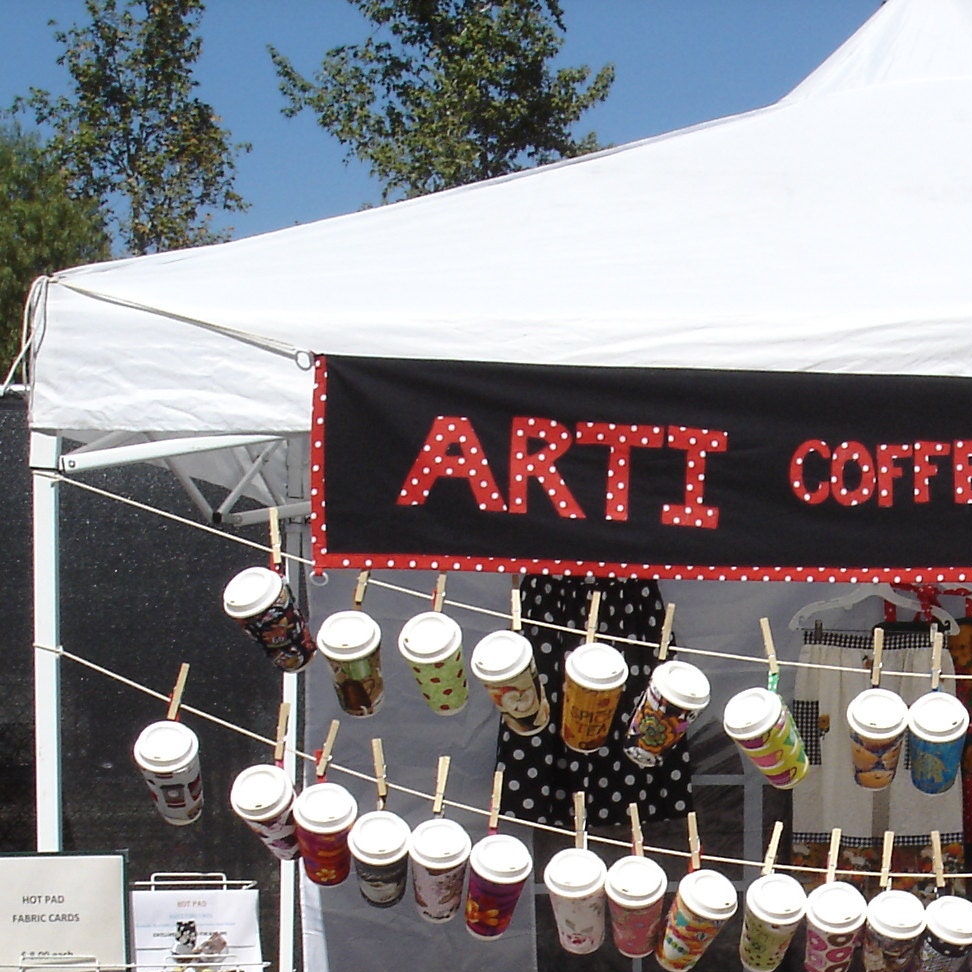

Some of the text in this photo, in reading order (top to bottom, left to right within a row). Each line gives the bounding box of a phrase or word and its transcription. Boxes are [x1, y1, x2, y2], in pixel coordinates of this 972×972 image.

[397, 415, 728, 530] ARTI
[22, 895, 65, 904] HOT PAD
[12, 913, 80, 923] FABRIC CARDS
